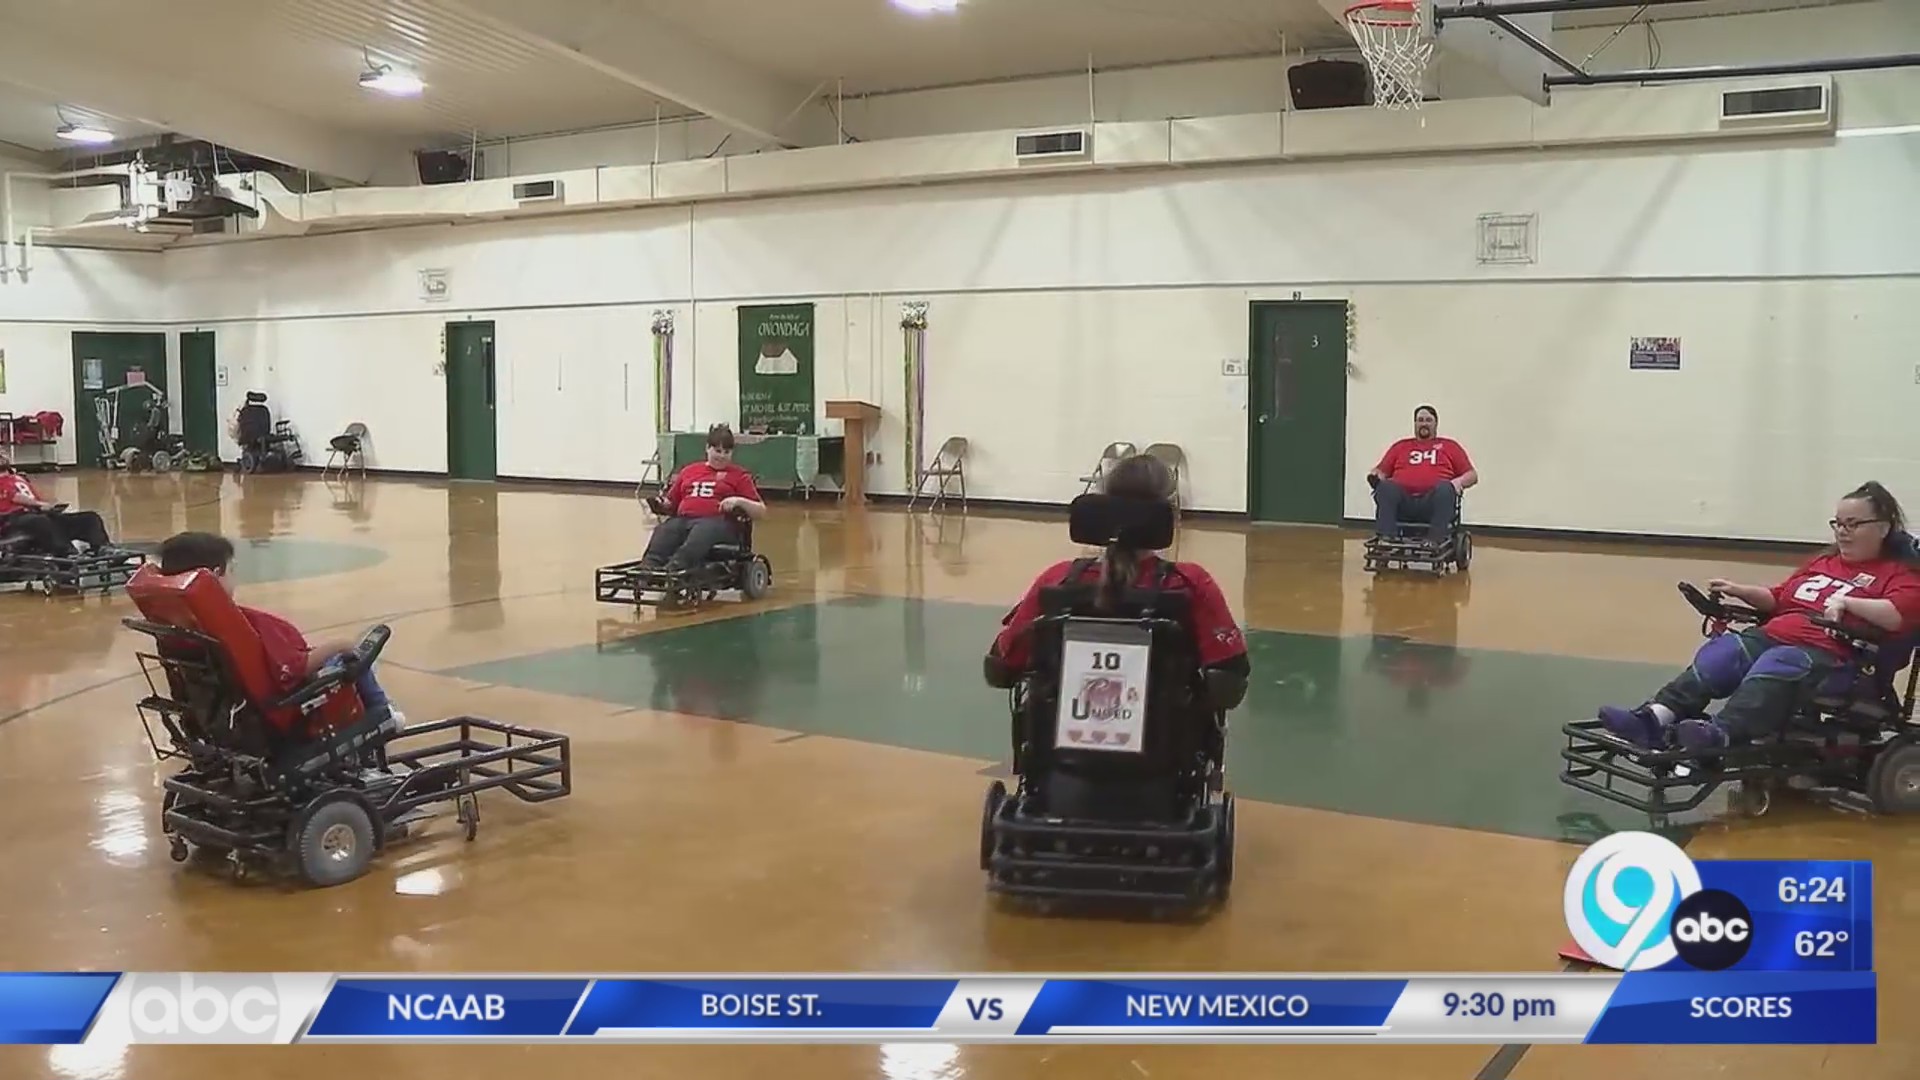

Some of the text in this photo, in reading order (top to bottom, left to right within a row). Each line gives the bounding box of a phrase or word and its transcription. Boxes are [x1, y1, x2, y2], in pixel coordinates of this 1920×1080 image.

[758, 321, 810, 337] ONONDAGA
[1311, 334, 1320, 349] 3
[1409, 449, 1437, 465] 34
[1793, 574, 1856, 607] 27
[1091, 652, 1121, 671] 10
